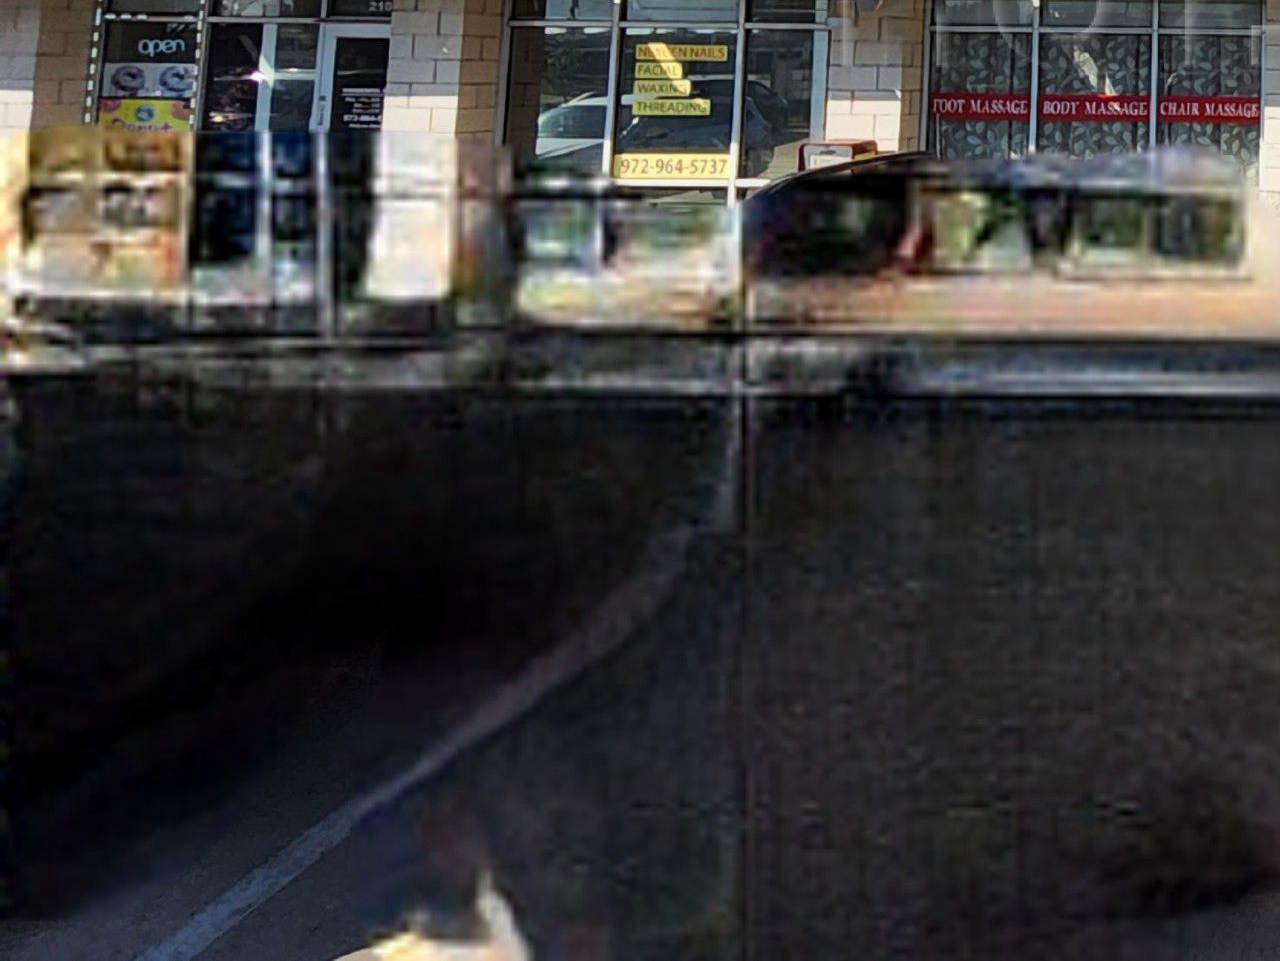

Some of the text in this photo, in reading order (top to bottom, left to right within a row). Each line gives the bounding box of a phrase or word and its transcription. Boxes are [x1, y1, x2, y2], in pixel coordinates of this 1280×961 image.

[138, 39, 186, 57] open
[690, 47, 725, 59] NAILS
[638, 64, 678, 75] FACIAL
[638, 83, 687, 94] WAXING
[636, 101, 707, 113] THREADING
[969, 99, 1029, 115] MASSAGE
[1043, 100, 1148, 116] BODY MASSAGE
[1160, 102, 1260, 117] CHAIR MASSAGE
[620, 159, 728, 174] 972-964-5737
